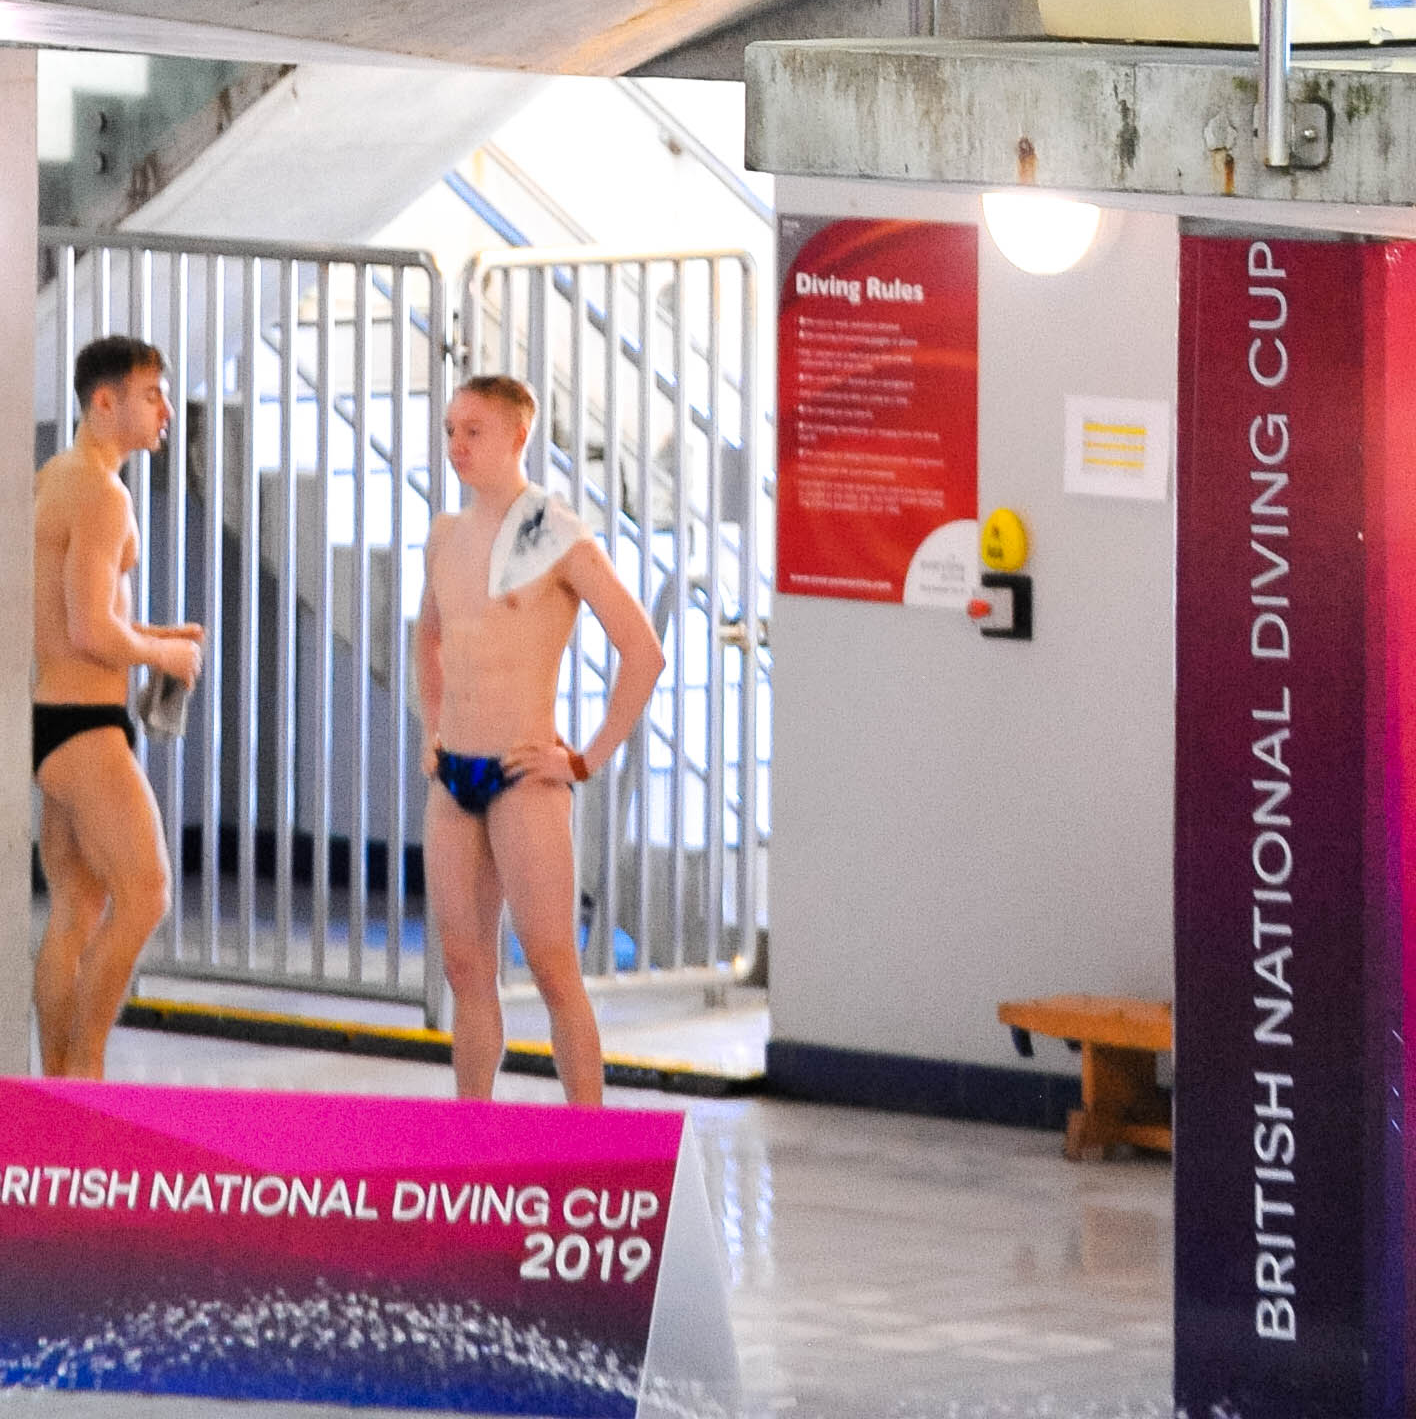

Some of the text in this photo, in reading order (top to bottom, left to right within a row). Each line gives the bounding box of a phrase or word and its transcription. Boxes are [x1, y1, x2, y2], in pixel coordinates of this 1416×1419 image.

[795, 272, 924, 303] Diving Rules
[1248, 240, 1297, 1341] BRITISH NATIONAL DIVING CUP
[148, 1171, 378, 1220] NATIONAL
[392, 1182, 550, 1227] DIVING
[562, 1188, 659, 1228] CUP
[520, 1233, 651, 1283] 2019
